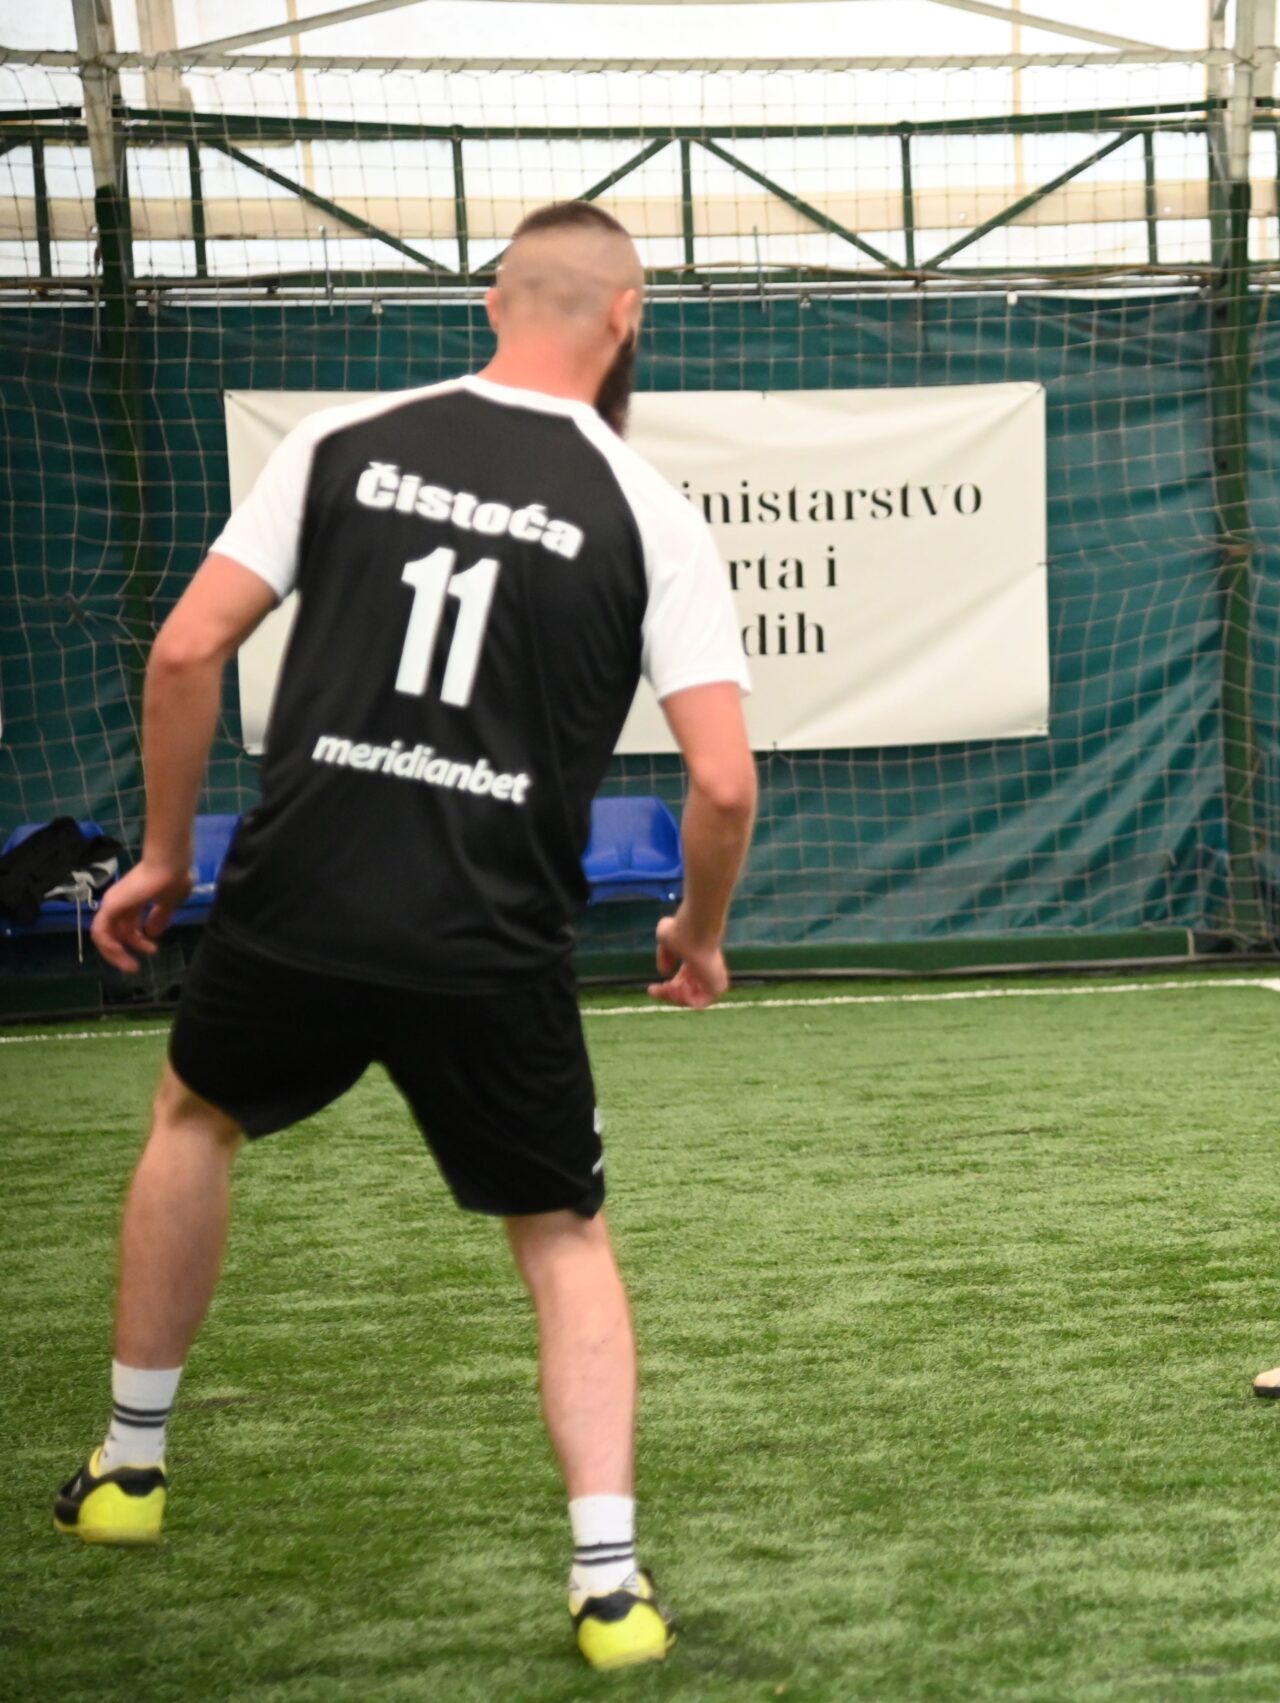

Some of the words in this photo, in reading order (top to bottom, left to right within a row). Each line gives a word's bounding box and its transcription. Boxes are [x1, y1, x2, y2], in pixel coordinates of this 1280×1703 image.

[356, 461, 584, 560] Čistoća
[682, 480, 982, 524] nistarstvo
[728, 554, 804, 591] rta
[826, 545, 838, 587] i
[395, 547, 500, 708] 11
[741, 612, 826, 657] dih
[312, 736, 530, 803] meridianbet
